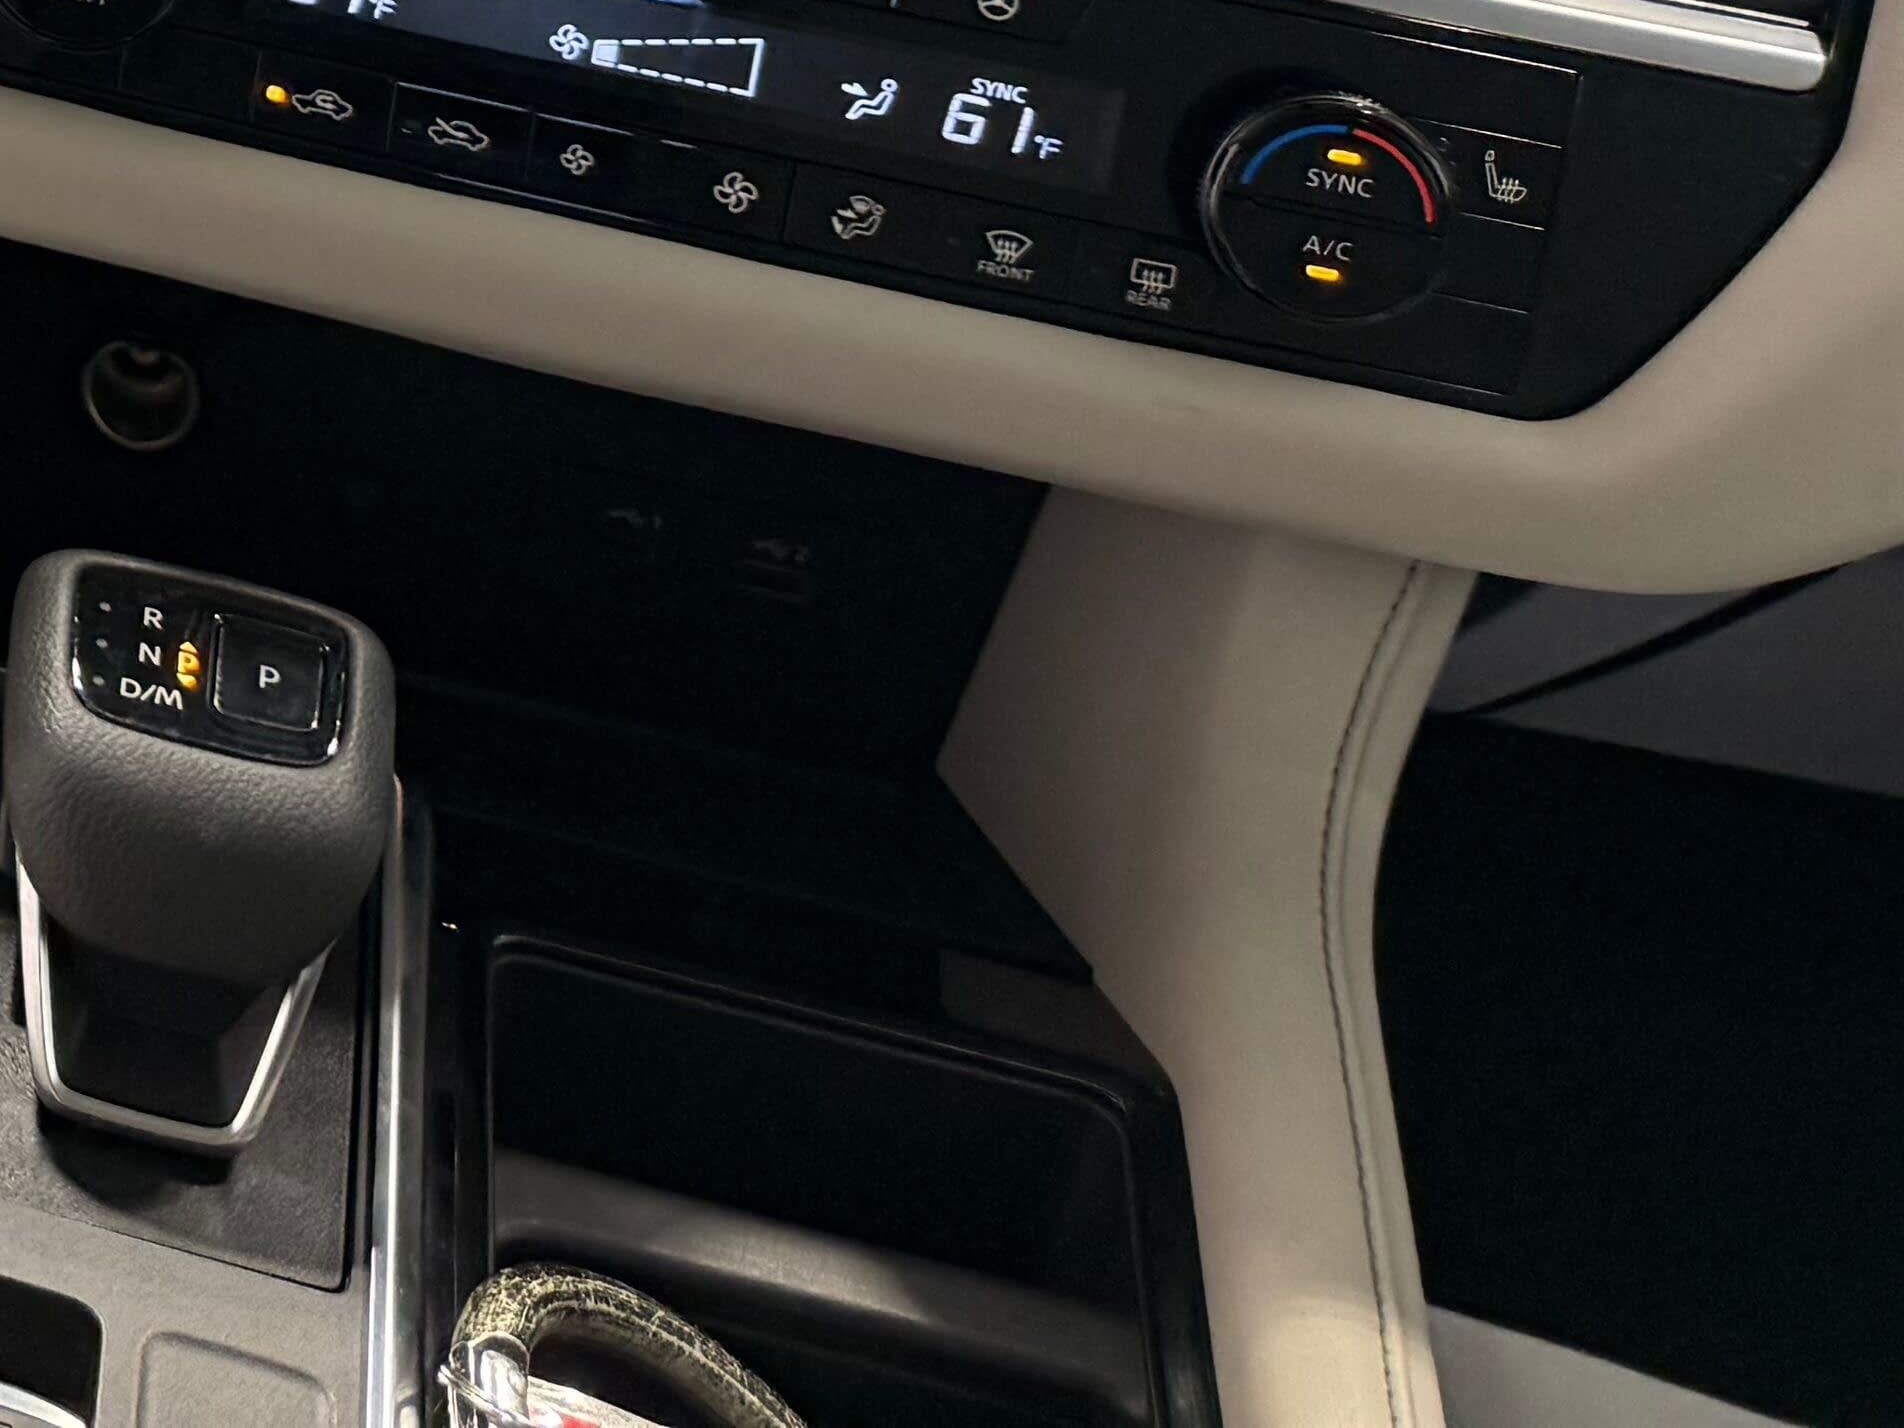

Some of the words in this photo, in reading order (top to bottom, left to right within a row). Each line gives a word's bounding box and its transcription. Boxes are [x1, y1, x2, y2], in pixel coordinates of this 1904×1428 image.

[970, 77, 1028, 104] SYNC
[1306, 168, 1374, 199] SYNC
[1302, 236, 1353, 261] A/C
[976, 259, 1035, 281] FRONT
[1125, 289, 1173, 311] REAR
[142, 606, 163, 630] R
[138, 642, 162, 667] N
[259, 663, 280, 689] P
[118, 675, 183, 711] D/M
